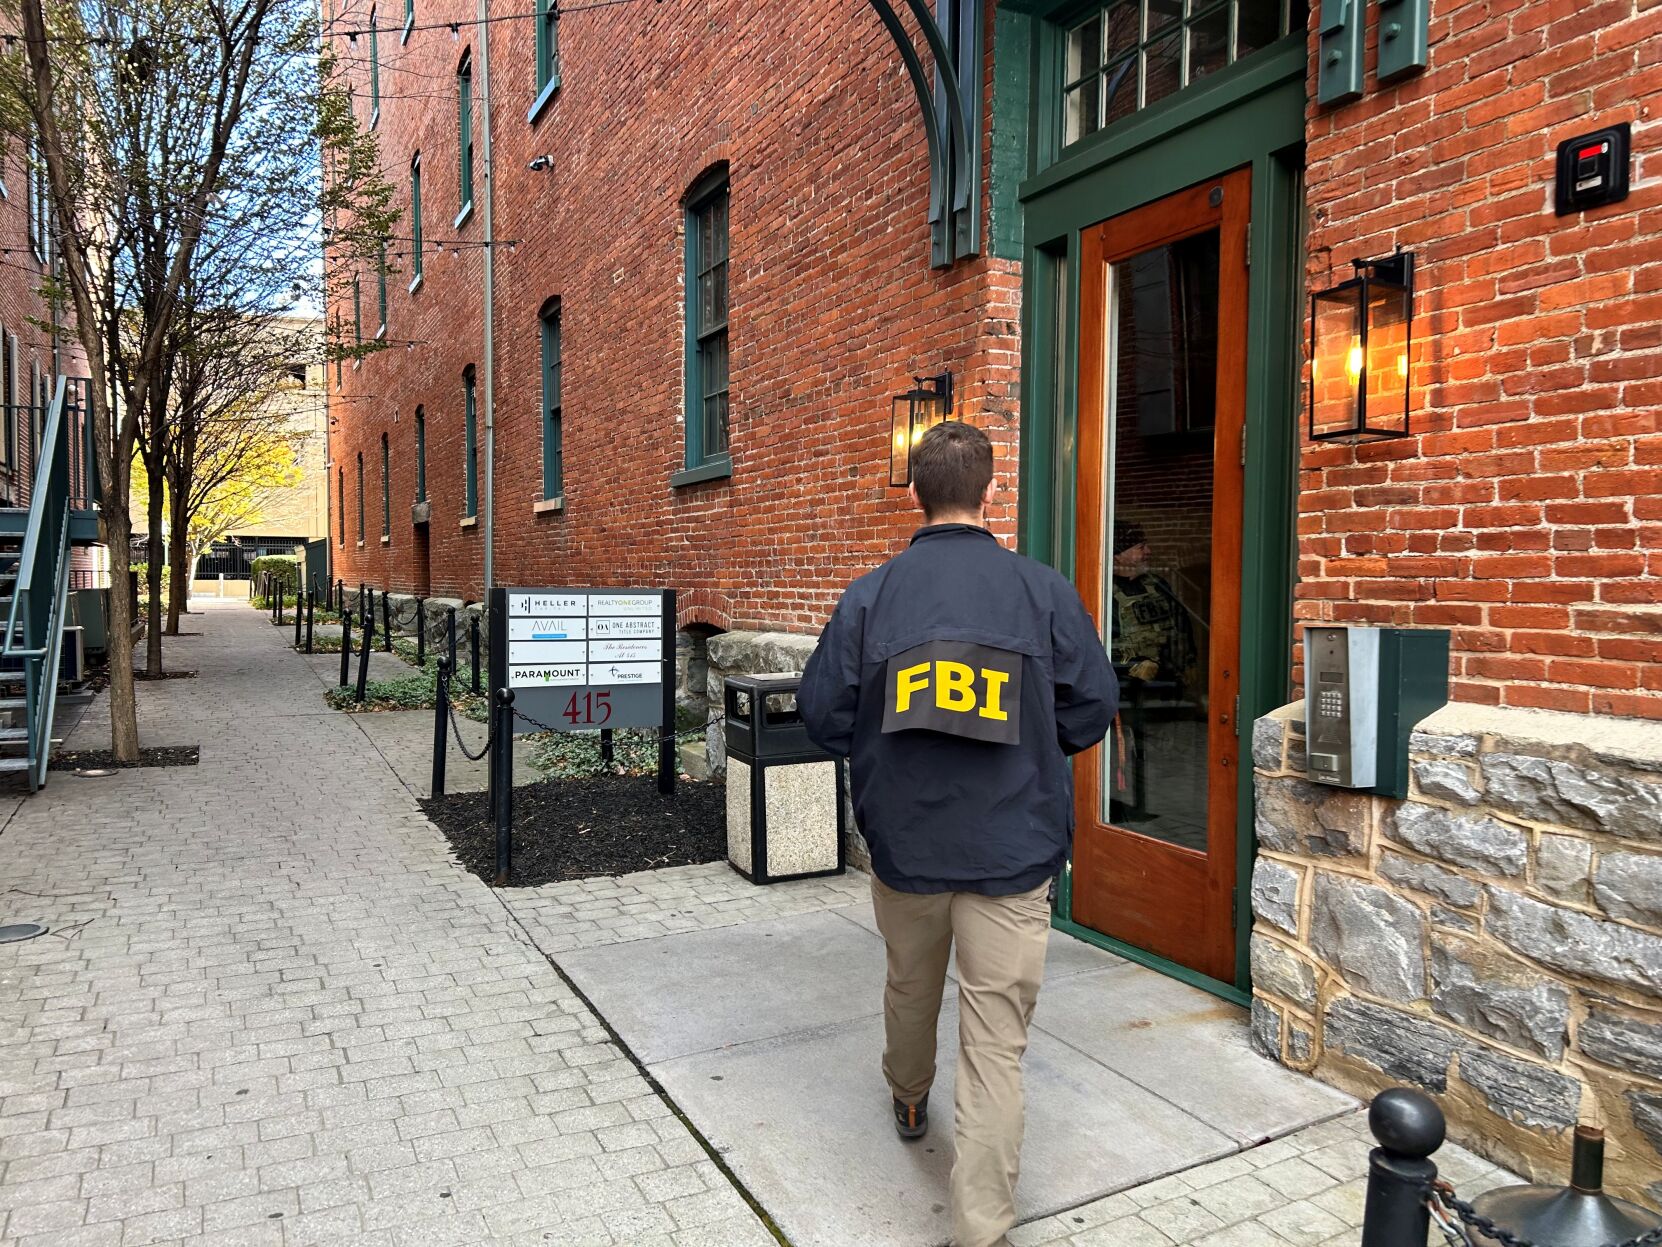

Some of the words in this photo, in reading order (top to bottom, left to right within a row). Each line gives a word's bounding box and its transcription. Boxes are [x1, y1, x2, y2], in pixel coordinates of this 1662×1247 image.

[532, 620, 568, 632] AVAIL
[612, 621, 623, 629] ONE
[625, 621, 655, 629] ABSTRACT
[515, 669, 580, 679] PARAMOUNT
[896, 660, 1010, 721] FBI
[562, 690, 612, 725] 415
